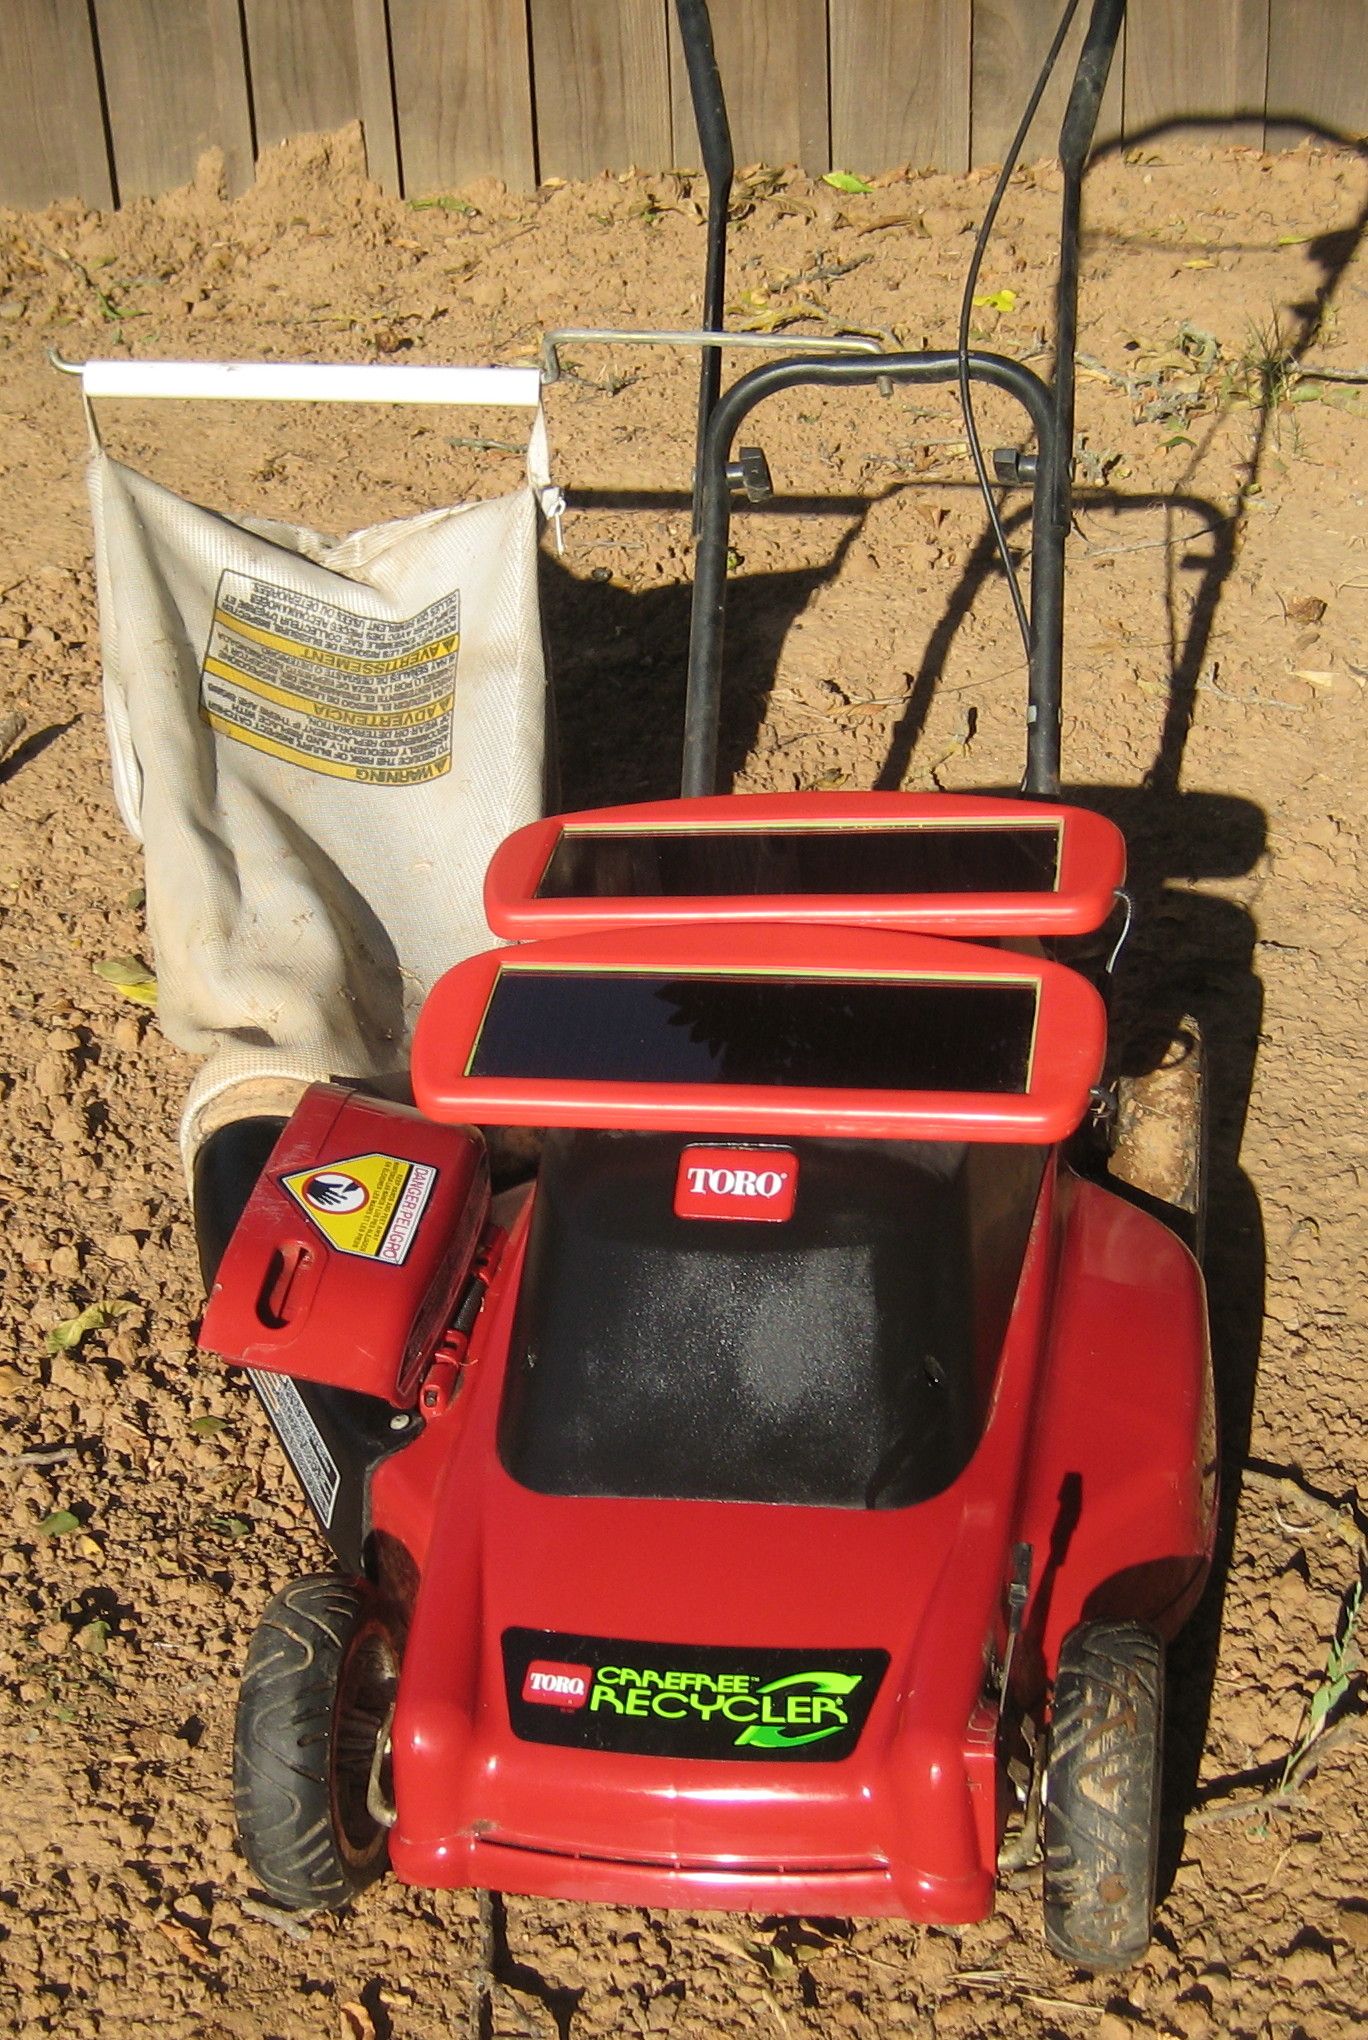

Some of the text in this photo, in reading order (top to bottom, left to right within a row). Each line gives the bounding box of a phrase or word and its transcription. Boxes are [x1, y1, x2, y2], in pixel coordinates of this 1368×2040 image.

[301, 644, 439, 675] AVERTISSEMENT
[314, 704, 436, 726] ADVERTENCIA
[356, 765, 432, 783] WARNING
[687, 1168, 782, 1198] TORO
[530, 1672, 585, 1696] TORO
[597, 1666, 750, 1694] CAREFREE
[590, 1684, 848, 1723] RECYCLER
